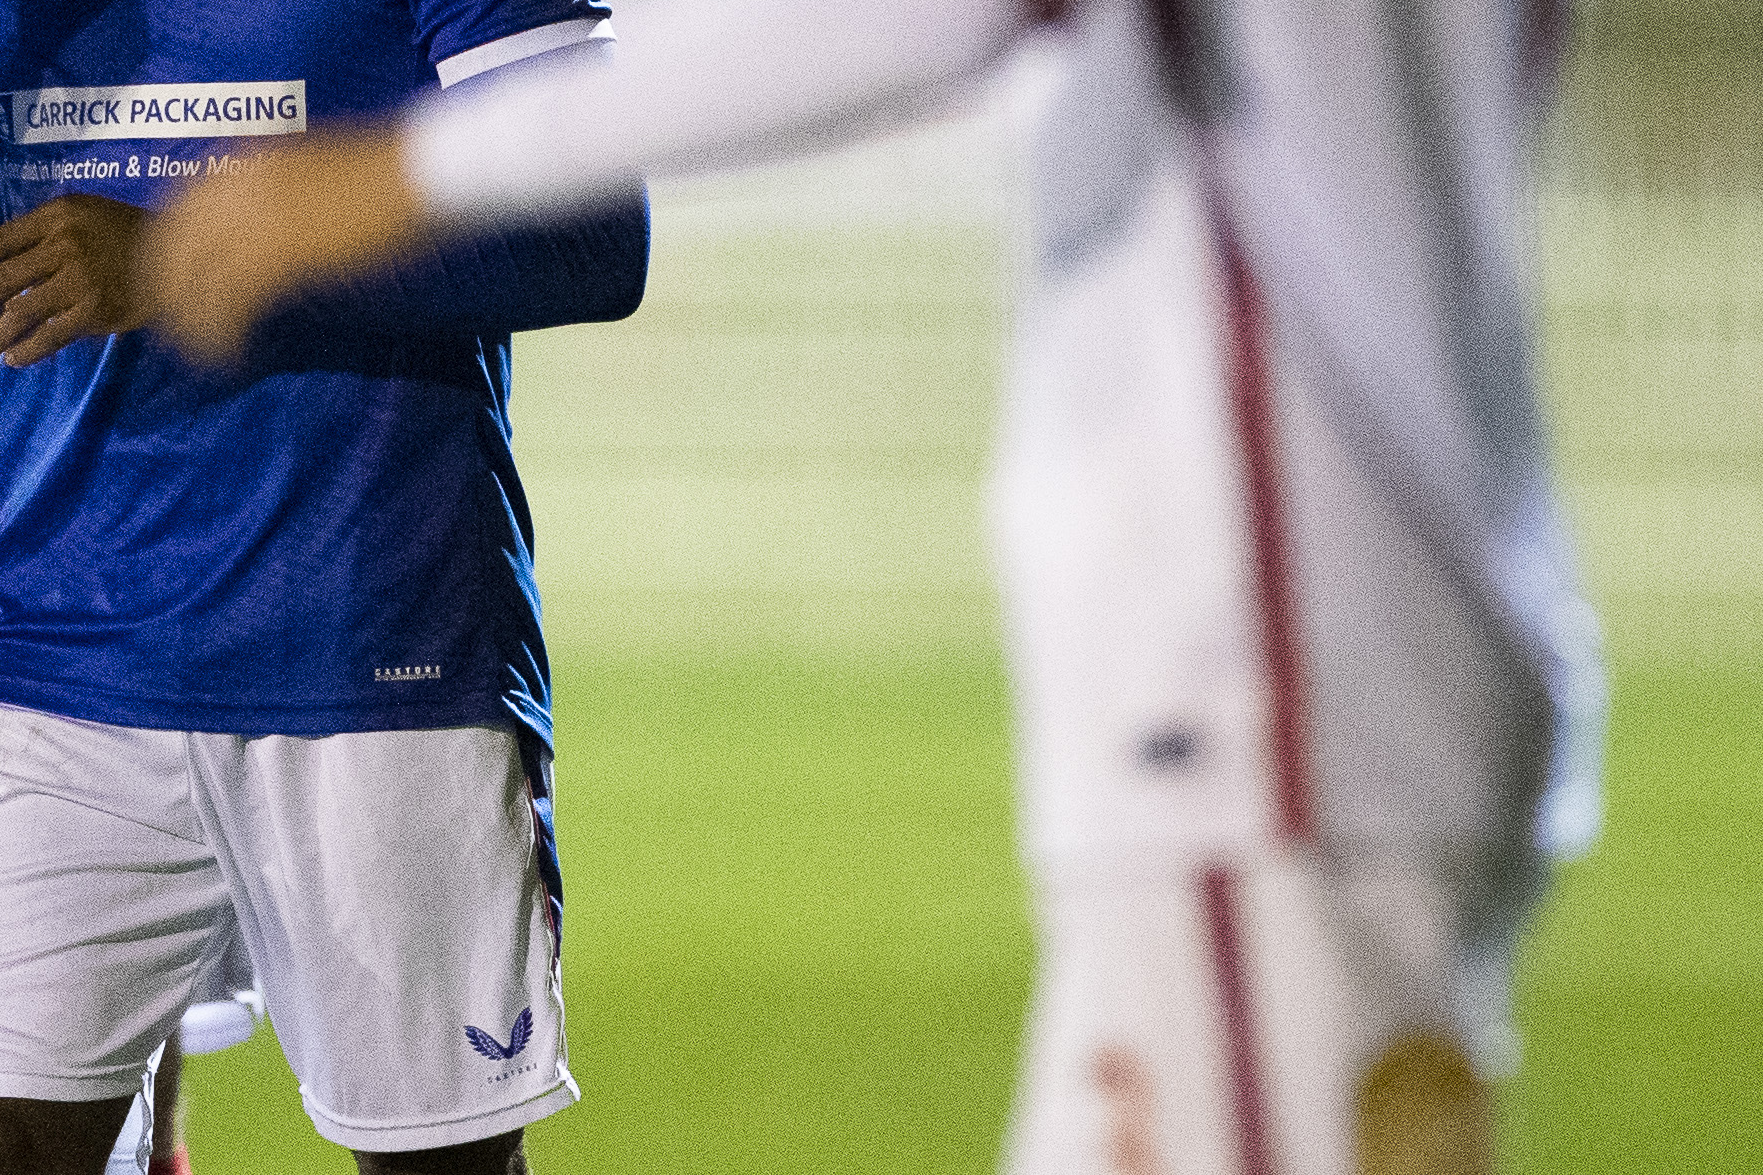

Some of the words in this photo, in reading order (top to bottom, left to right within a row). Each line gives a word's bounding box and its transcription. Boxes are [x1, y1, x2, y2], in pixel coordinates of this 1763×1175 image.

[27, 99, 120, 129] CARRICK
[129, 94, 299, 124] PACKAGING
[51, 157, 120, 184] Injection
[125, 155, 141, 178] &
[147, 154, 201, 177] Blow
